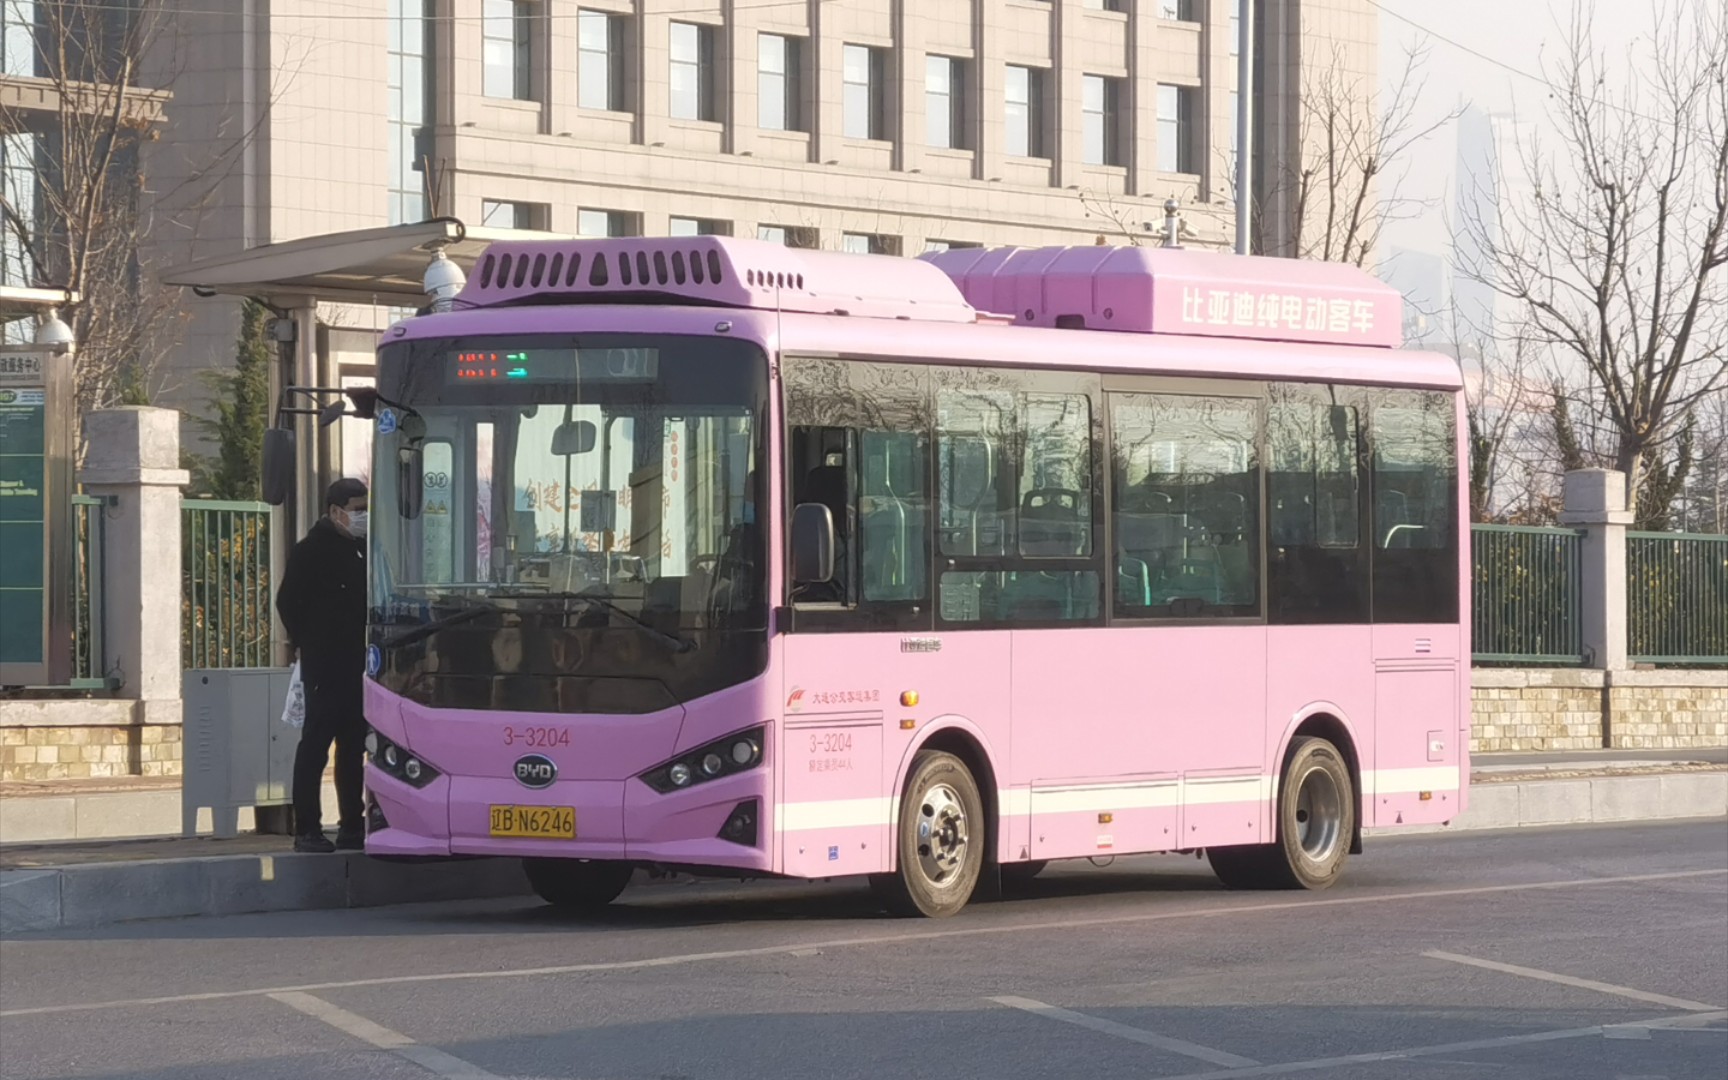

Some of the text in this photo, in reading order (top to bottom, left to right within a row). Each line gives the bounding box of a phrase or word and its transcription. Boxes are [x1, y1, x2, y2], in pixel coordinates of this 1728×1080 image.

[1182, 286, 1374, 333] 比亚迪纯电动客车
[503, 726, 570, 747] 3-3204
[809, 733, 852, 753] 3-3204
[517, 763, 551, 778] BYD
